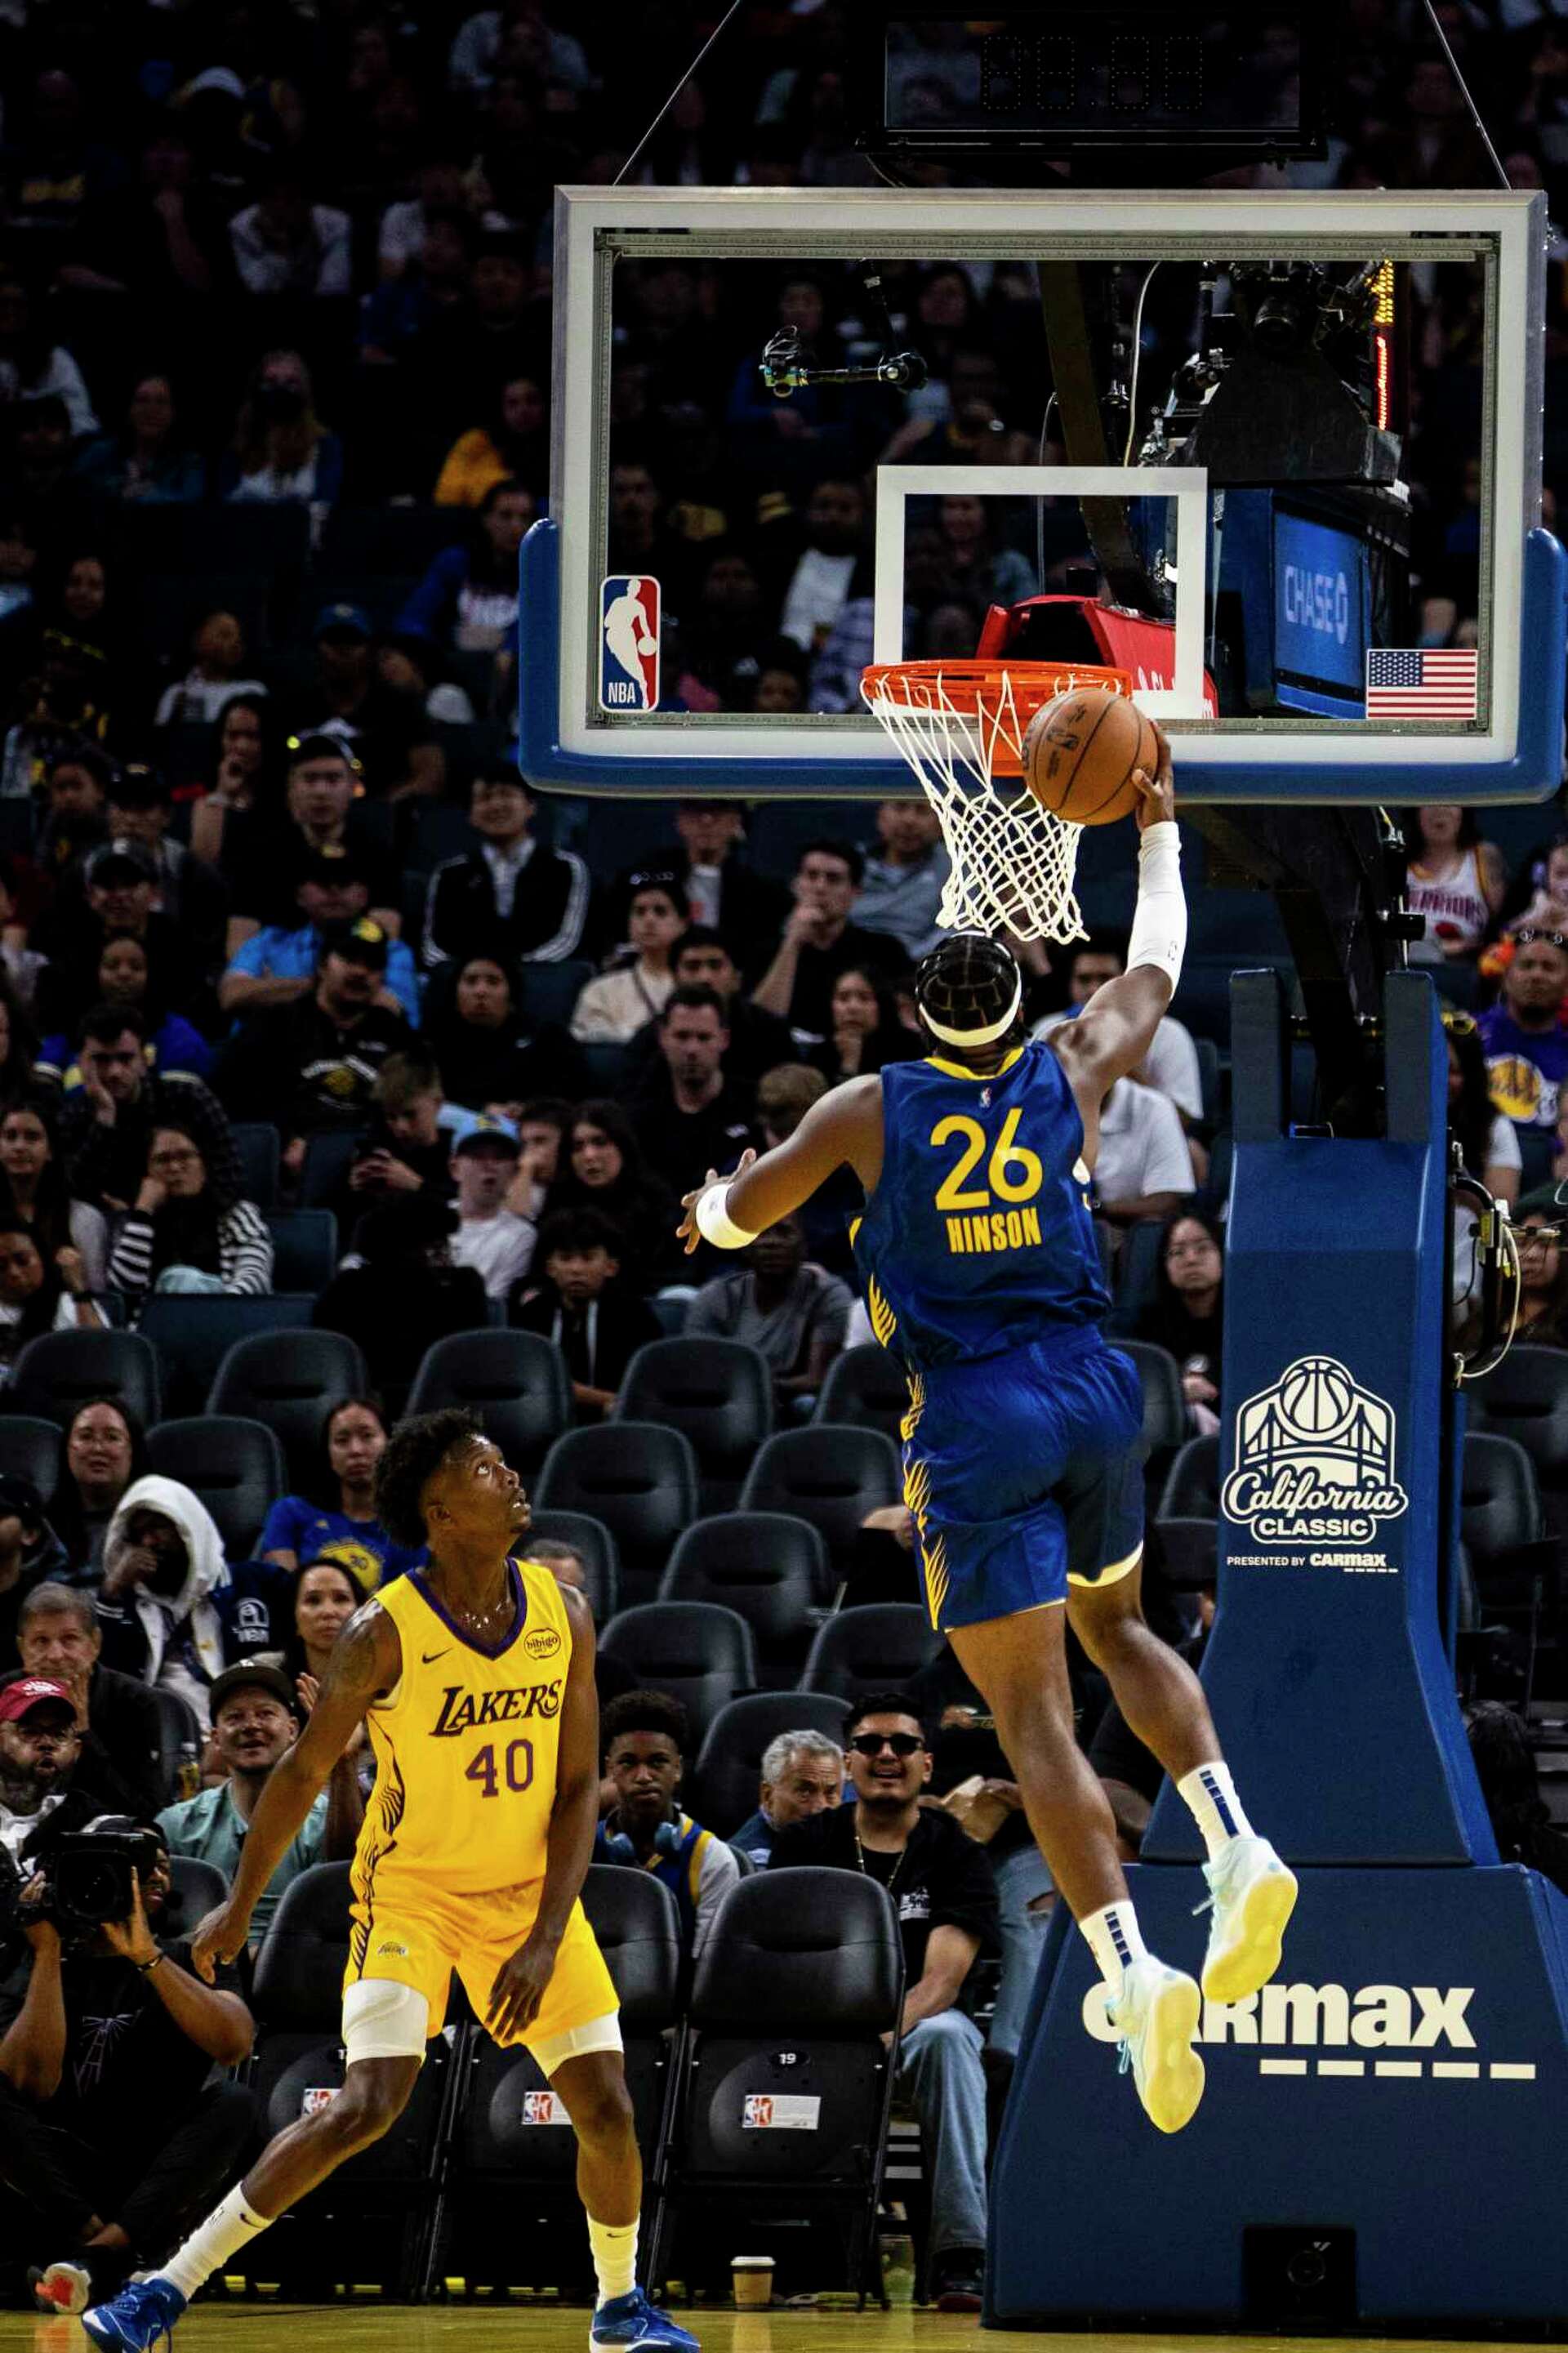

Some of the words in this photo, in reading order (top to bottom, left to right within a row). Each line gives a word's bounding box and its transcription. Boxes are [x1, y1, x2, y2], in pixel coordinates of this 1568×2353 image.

[1285, 565, 1334, 634] CHASE
[608, 682, 636, 703] NBA
[930, 1107, 1043, 1210] 26
[946, 1207, 1042, 1253] HINSON
[1228, 1470, 1399, 1517] California
[1258, 1518, 1369, 1535] CLASSIC
[1227, 1556, 1289, 1566] PRESENTED
[1291, 1557, 1305, 1566] BY
[429, 1679, 562, 1737] LAKERS
[466, 1739, 533, 1798] 40
[778, 2052, 797, 2066] 19
